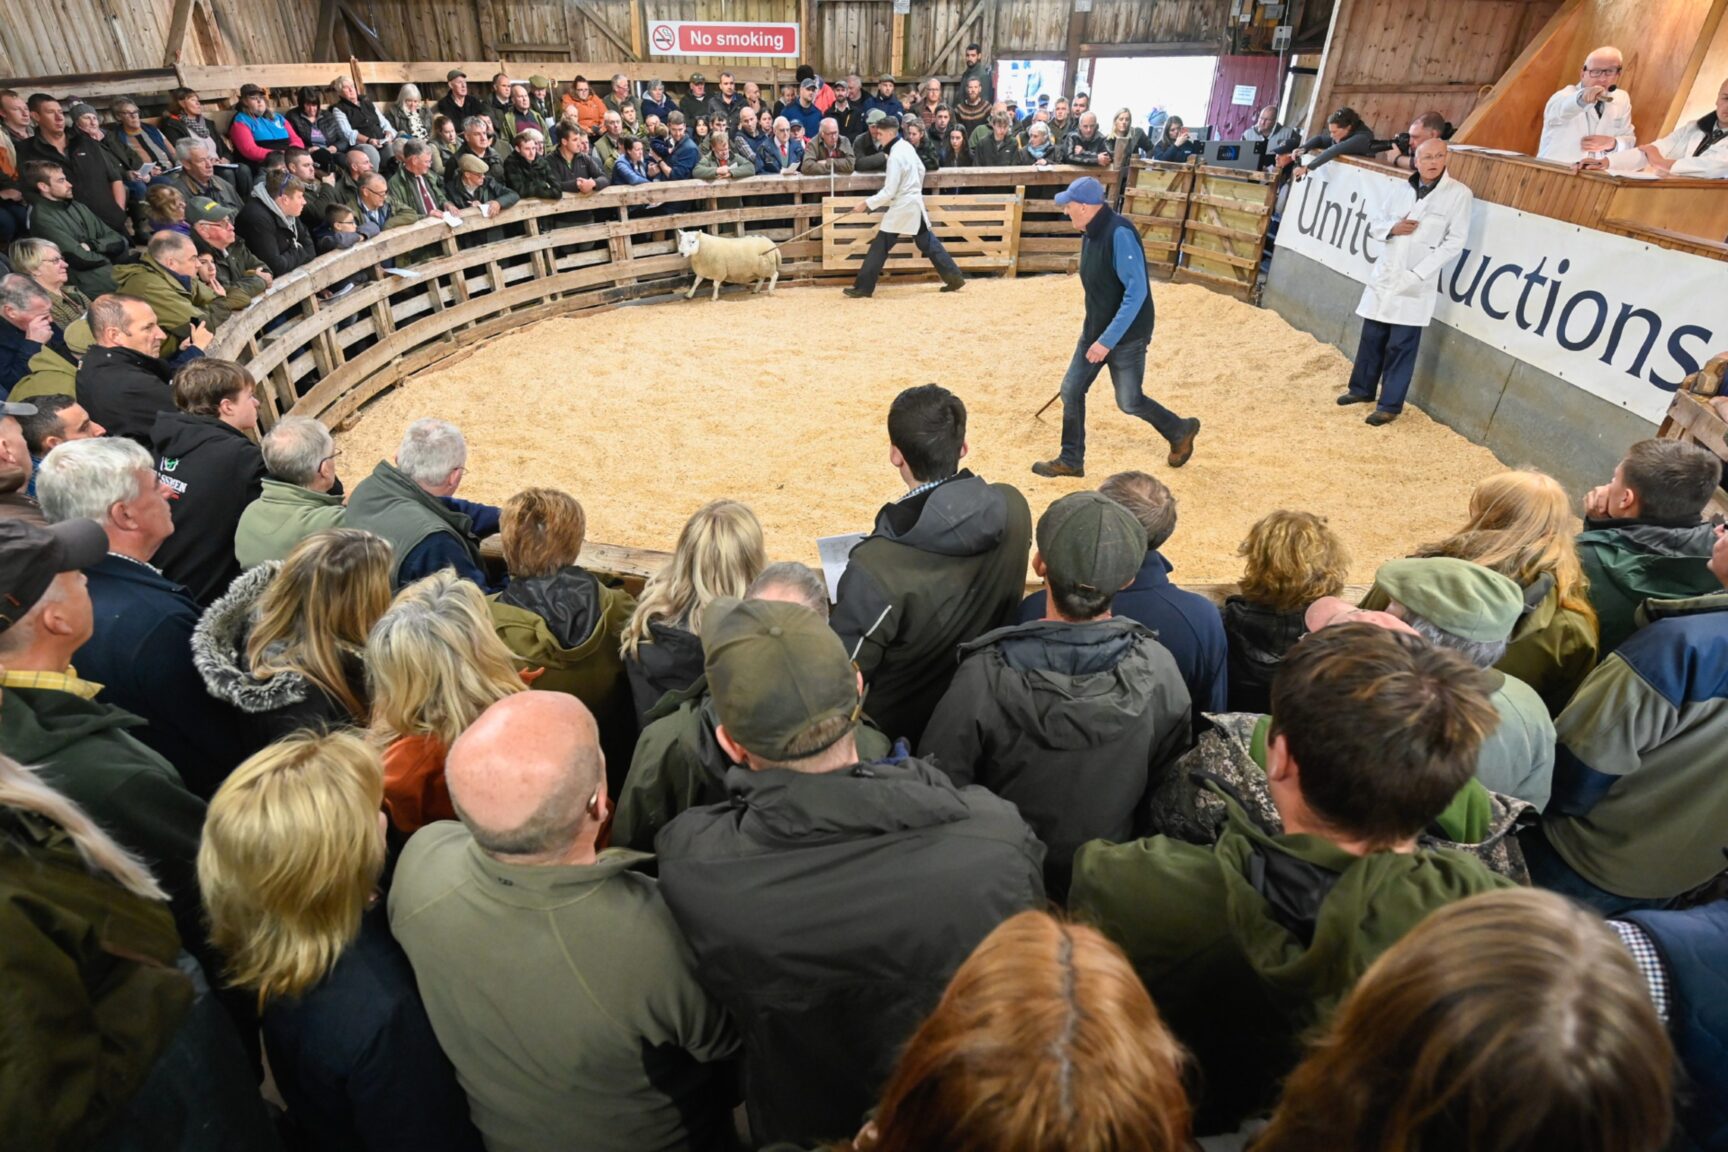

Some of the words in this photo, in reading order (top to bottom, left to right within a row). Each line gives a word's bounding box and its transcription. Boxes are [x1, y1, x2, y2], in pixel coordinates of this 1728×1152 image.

[690, 30, 712, 46] No
[716, 31, 784, 50] smoking
[1297, 176, 1379, 264] Unite
[1437, 247, 1713, 393] uctions
